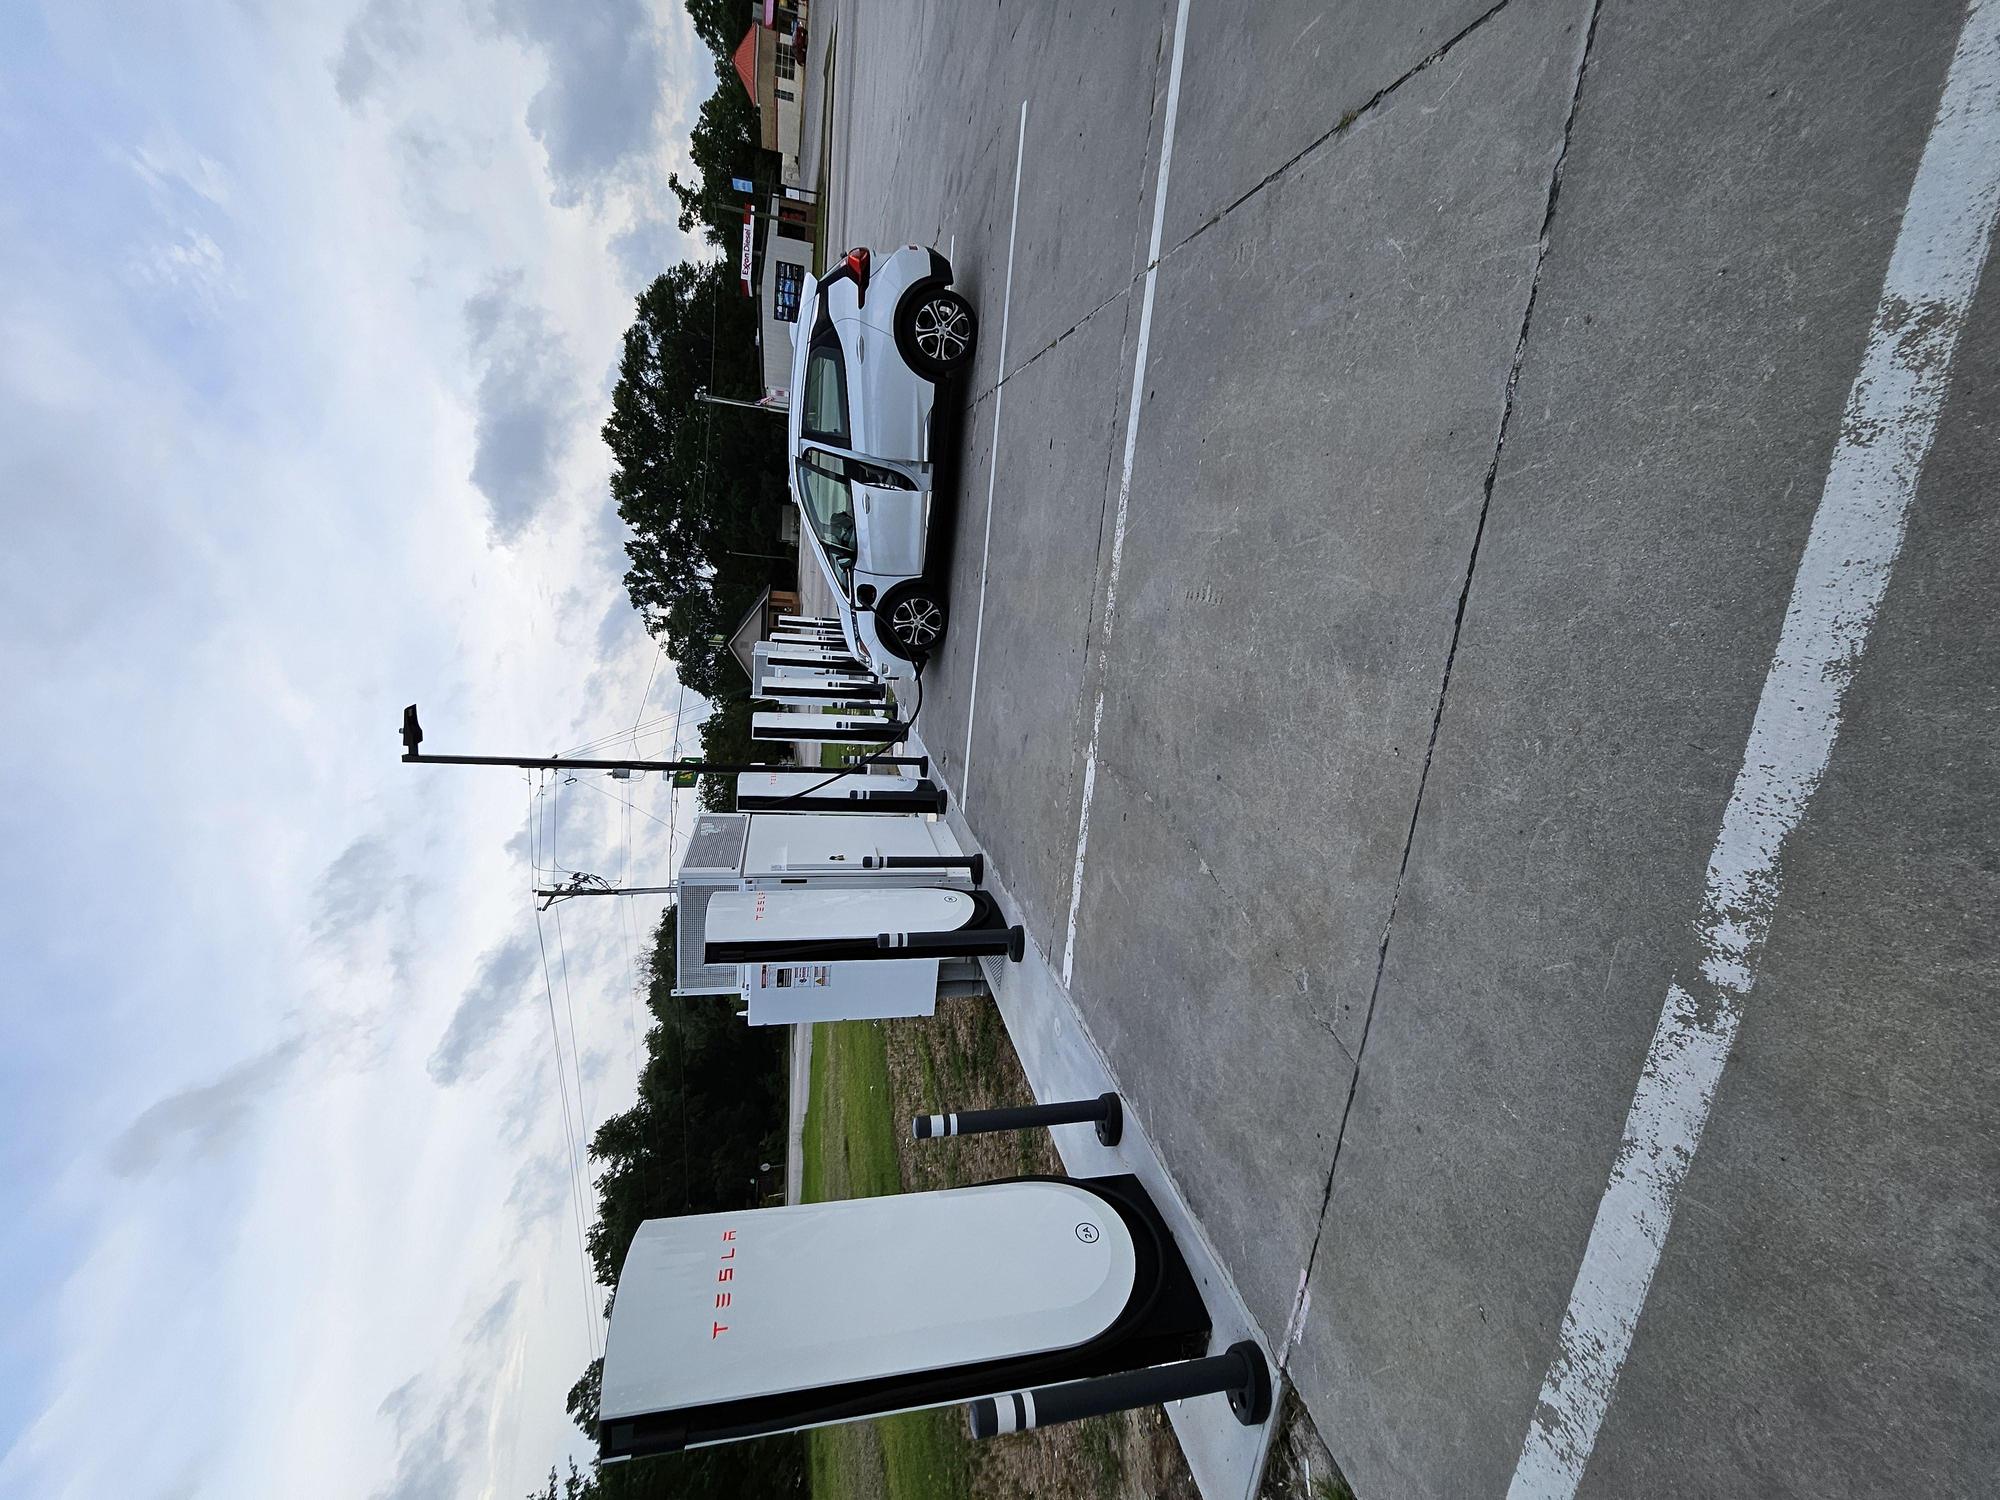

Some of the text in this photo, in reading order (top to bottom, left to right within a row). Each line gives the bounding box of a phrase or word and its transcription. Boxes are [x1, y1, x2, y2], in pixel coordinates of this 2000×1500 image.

[742, 252, 752, 275] Exxon
[1082, 1226, 1093, 1239] 2A
[712, 1230, 737, 1340] TESLA
